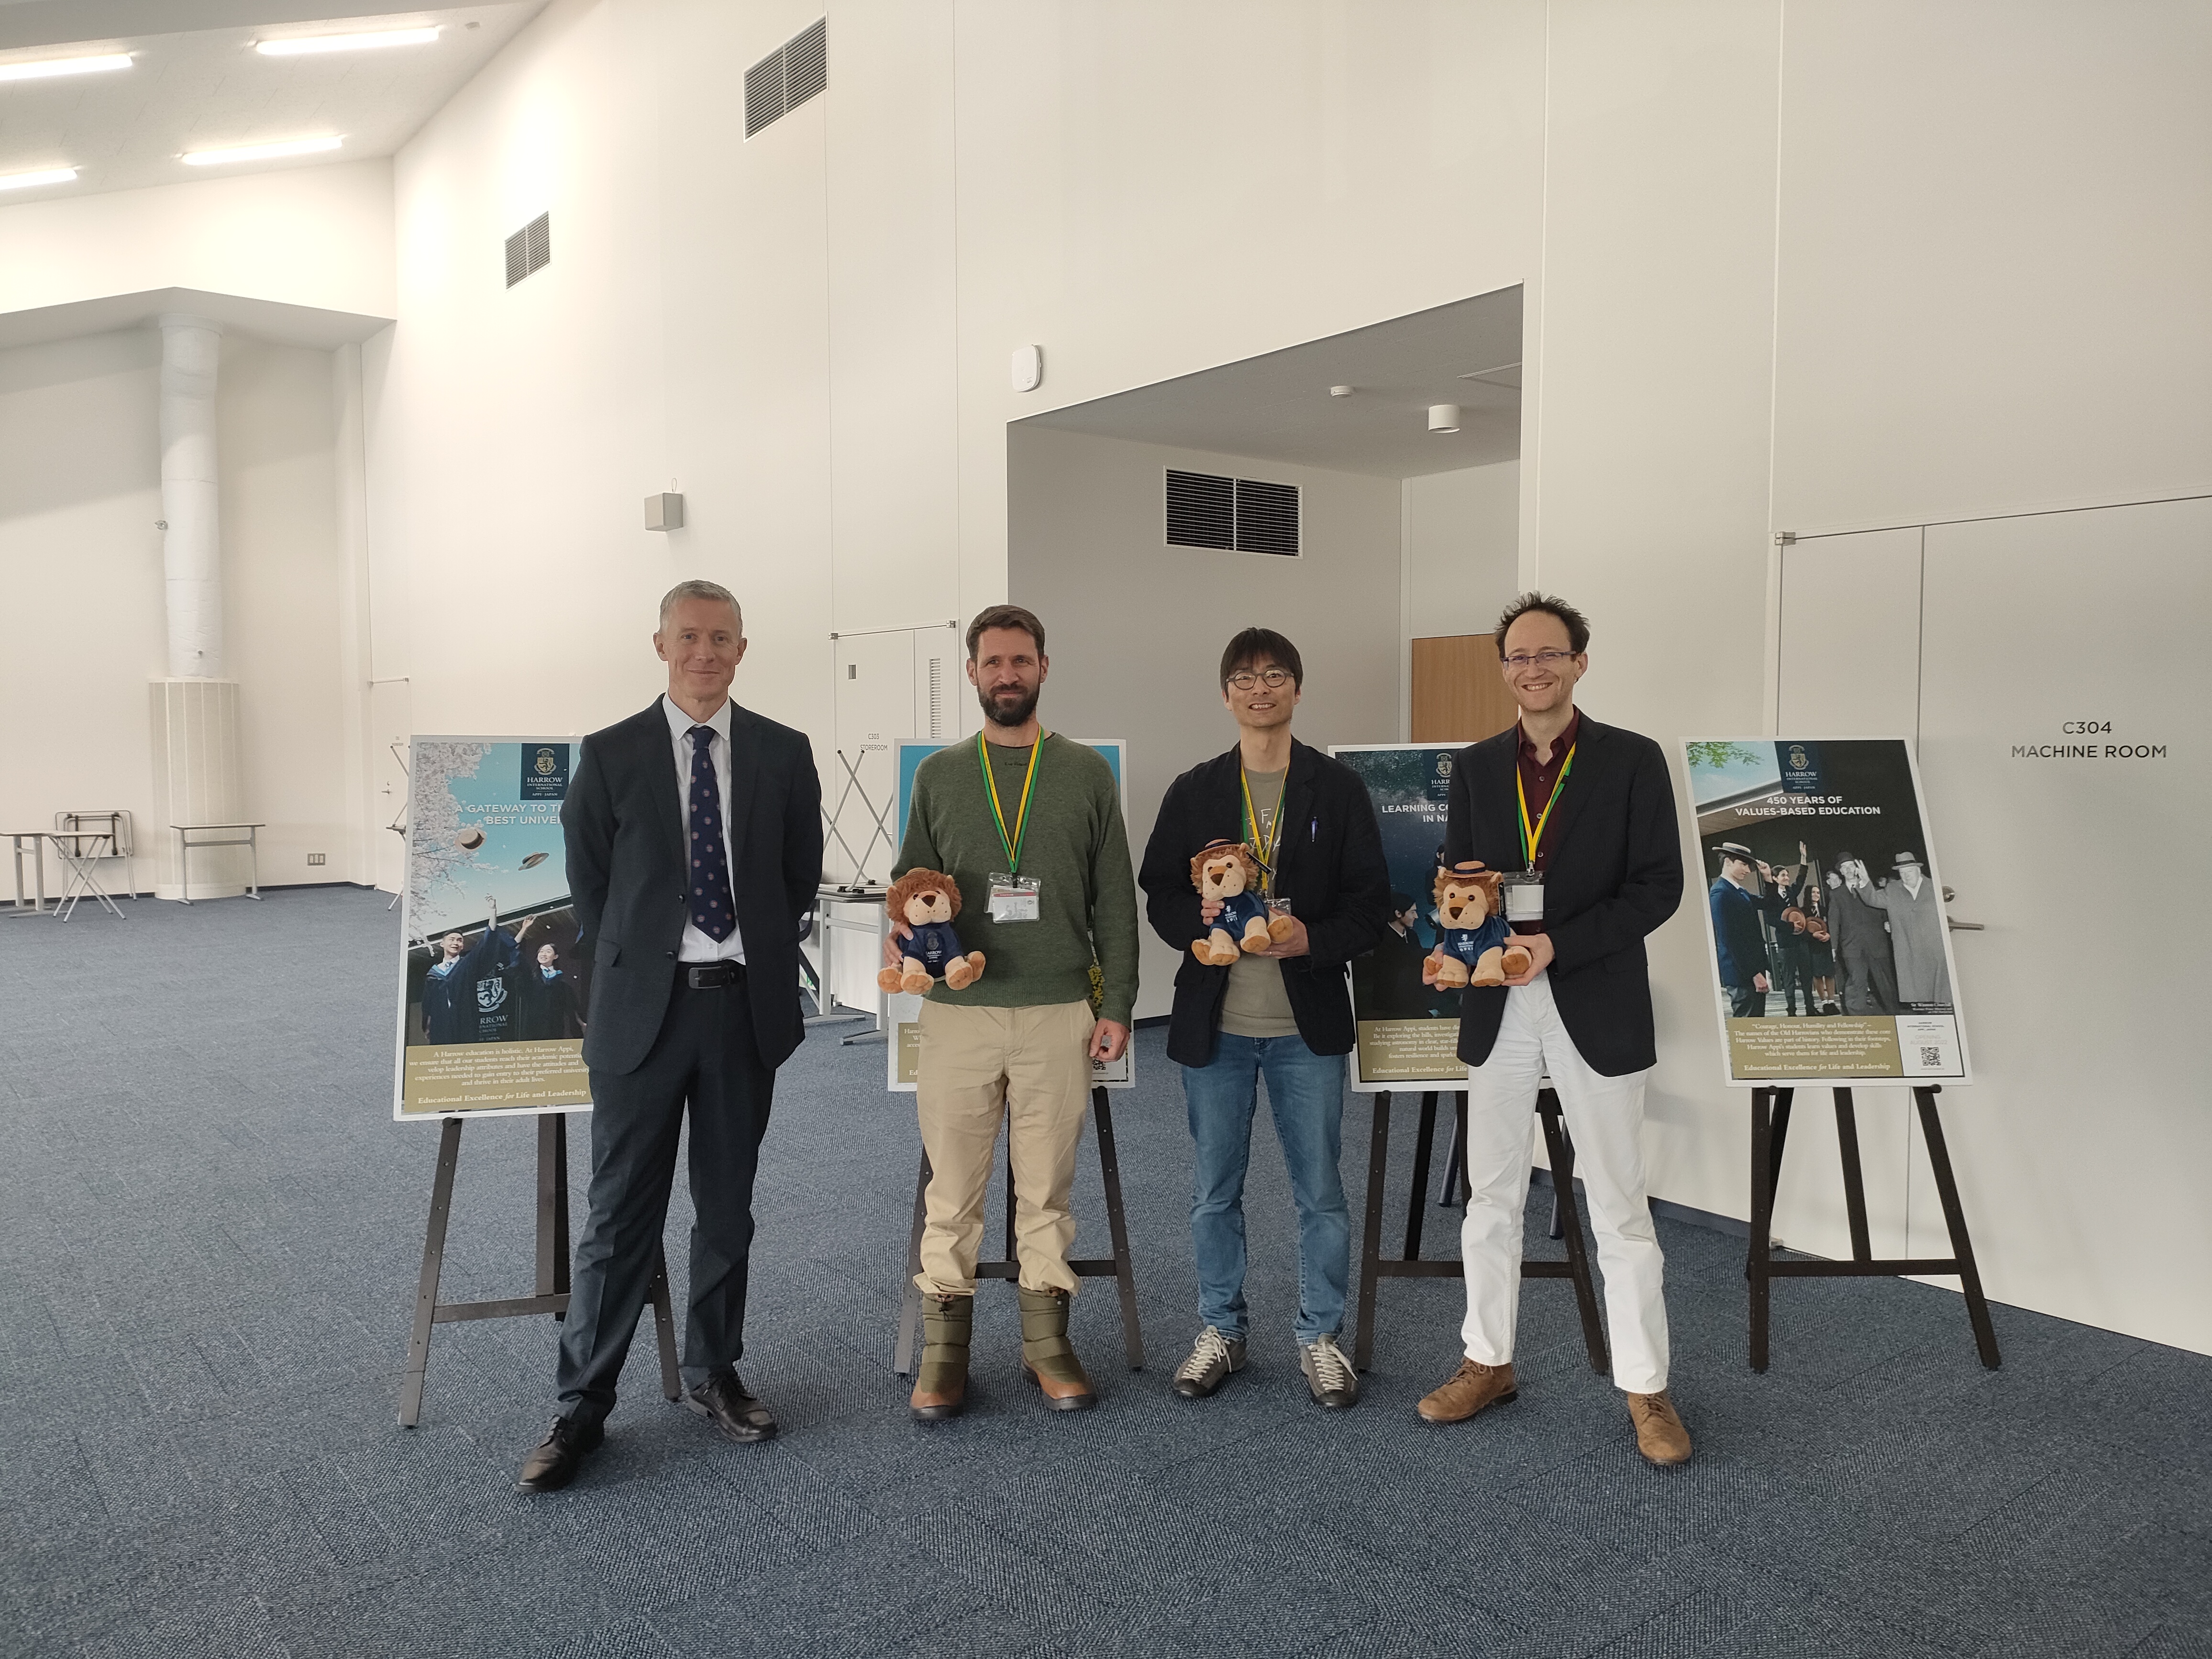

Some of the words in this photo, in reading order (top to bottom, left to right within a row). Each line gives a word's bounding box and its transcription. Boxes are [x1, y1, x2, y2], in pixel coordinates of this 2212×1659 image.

[2062, 721, 2112, 734] C304
[2011, 745, 2097, 758] MACHINE
[2105, 745, 2167, 758] ROOM
[1382, 804, 1435, 813] LEARNING
[1735, 807, 1816, 816] VALUES-BASED
[1819, 807, 1880, 815] EDUCATION
[486, 816, 516, 824] BEST
[418, 1095, 462, 1104] Educational
